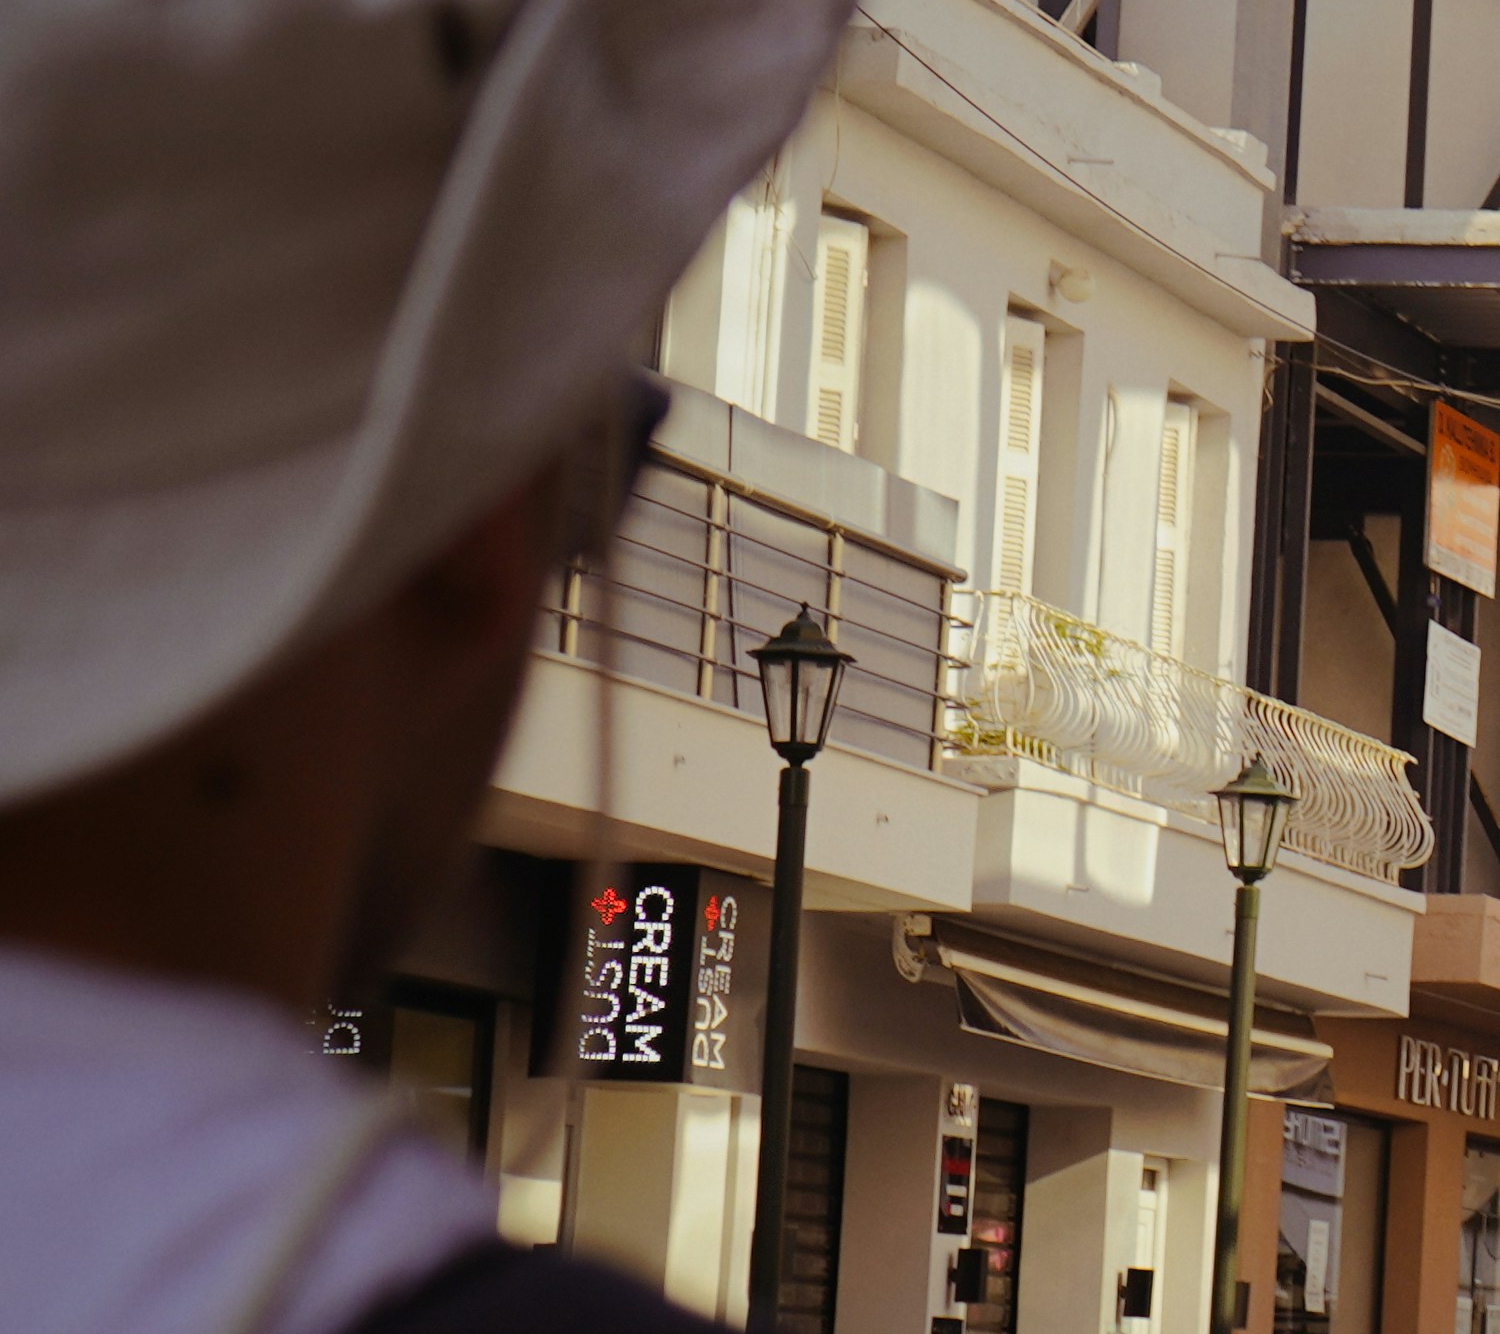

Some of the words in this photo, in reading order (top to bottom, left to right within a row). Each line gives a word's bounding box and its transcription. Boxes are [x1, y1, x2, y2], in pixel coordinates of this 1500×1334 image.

[579, 928, 625, 1061] DUST
[622, 886, 674, 1062] CREAM
[692, 935, 717, 1067] DUST
[709, 896, 738, 1070] CREAM
